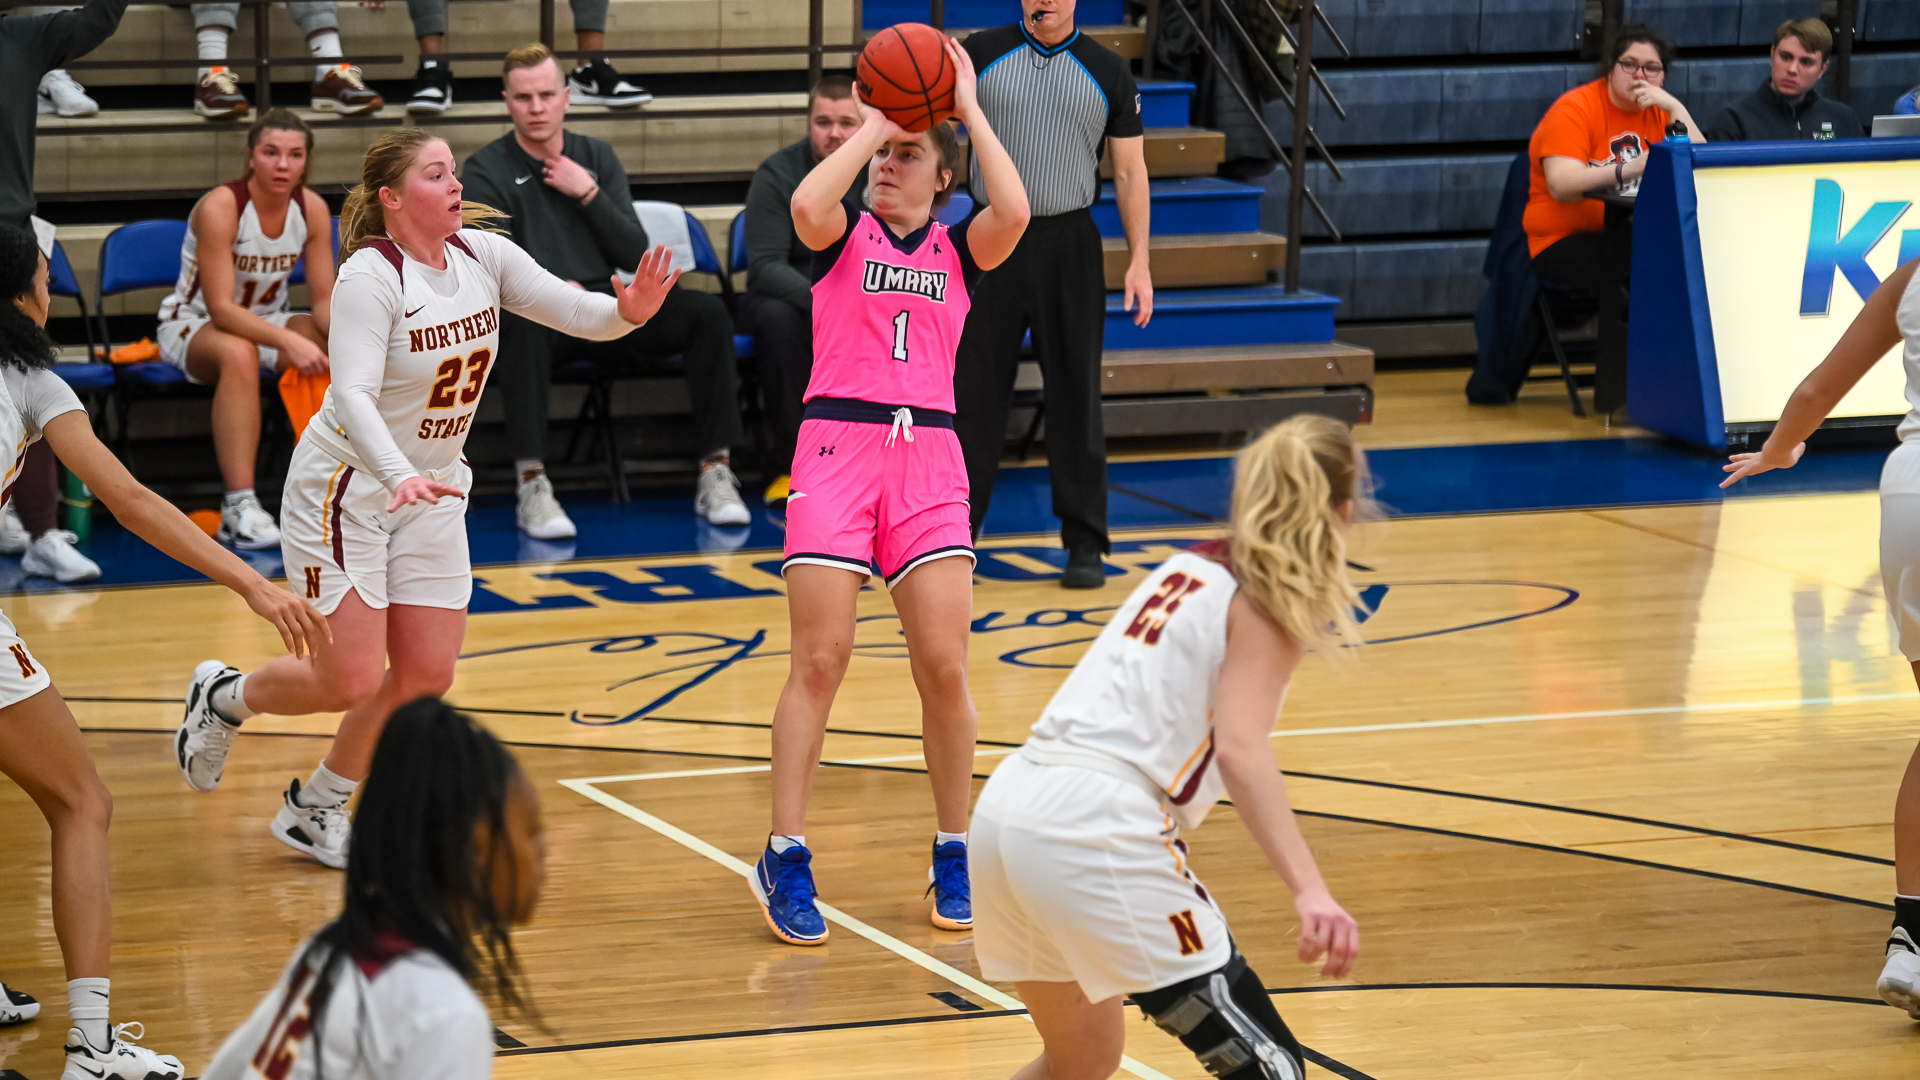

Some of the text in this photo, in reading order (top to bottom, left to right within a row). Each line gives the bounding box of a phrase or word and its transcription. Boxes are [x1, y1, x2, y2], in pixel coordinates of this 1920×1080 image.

[1799, 178, 1920, 318] K
[239, 279, 283, 310] 14
[862, 259, 949, 304] UMARY
[892, 309, 910, 363] 1
[426, 346, 492, 410] 23
[417, 411, 473, 440] STATE
[304, 565, 322, 600] N
[1123, 571, 1207, 647] 25
[7, 642, 38, 680] N
[1167, 908, 1206, 957] N
